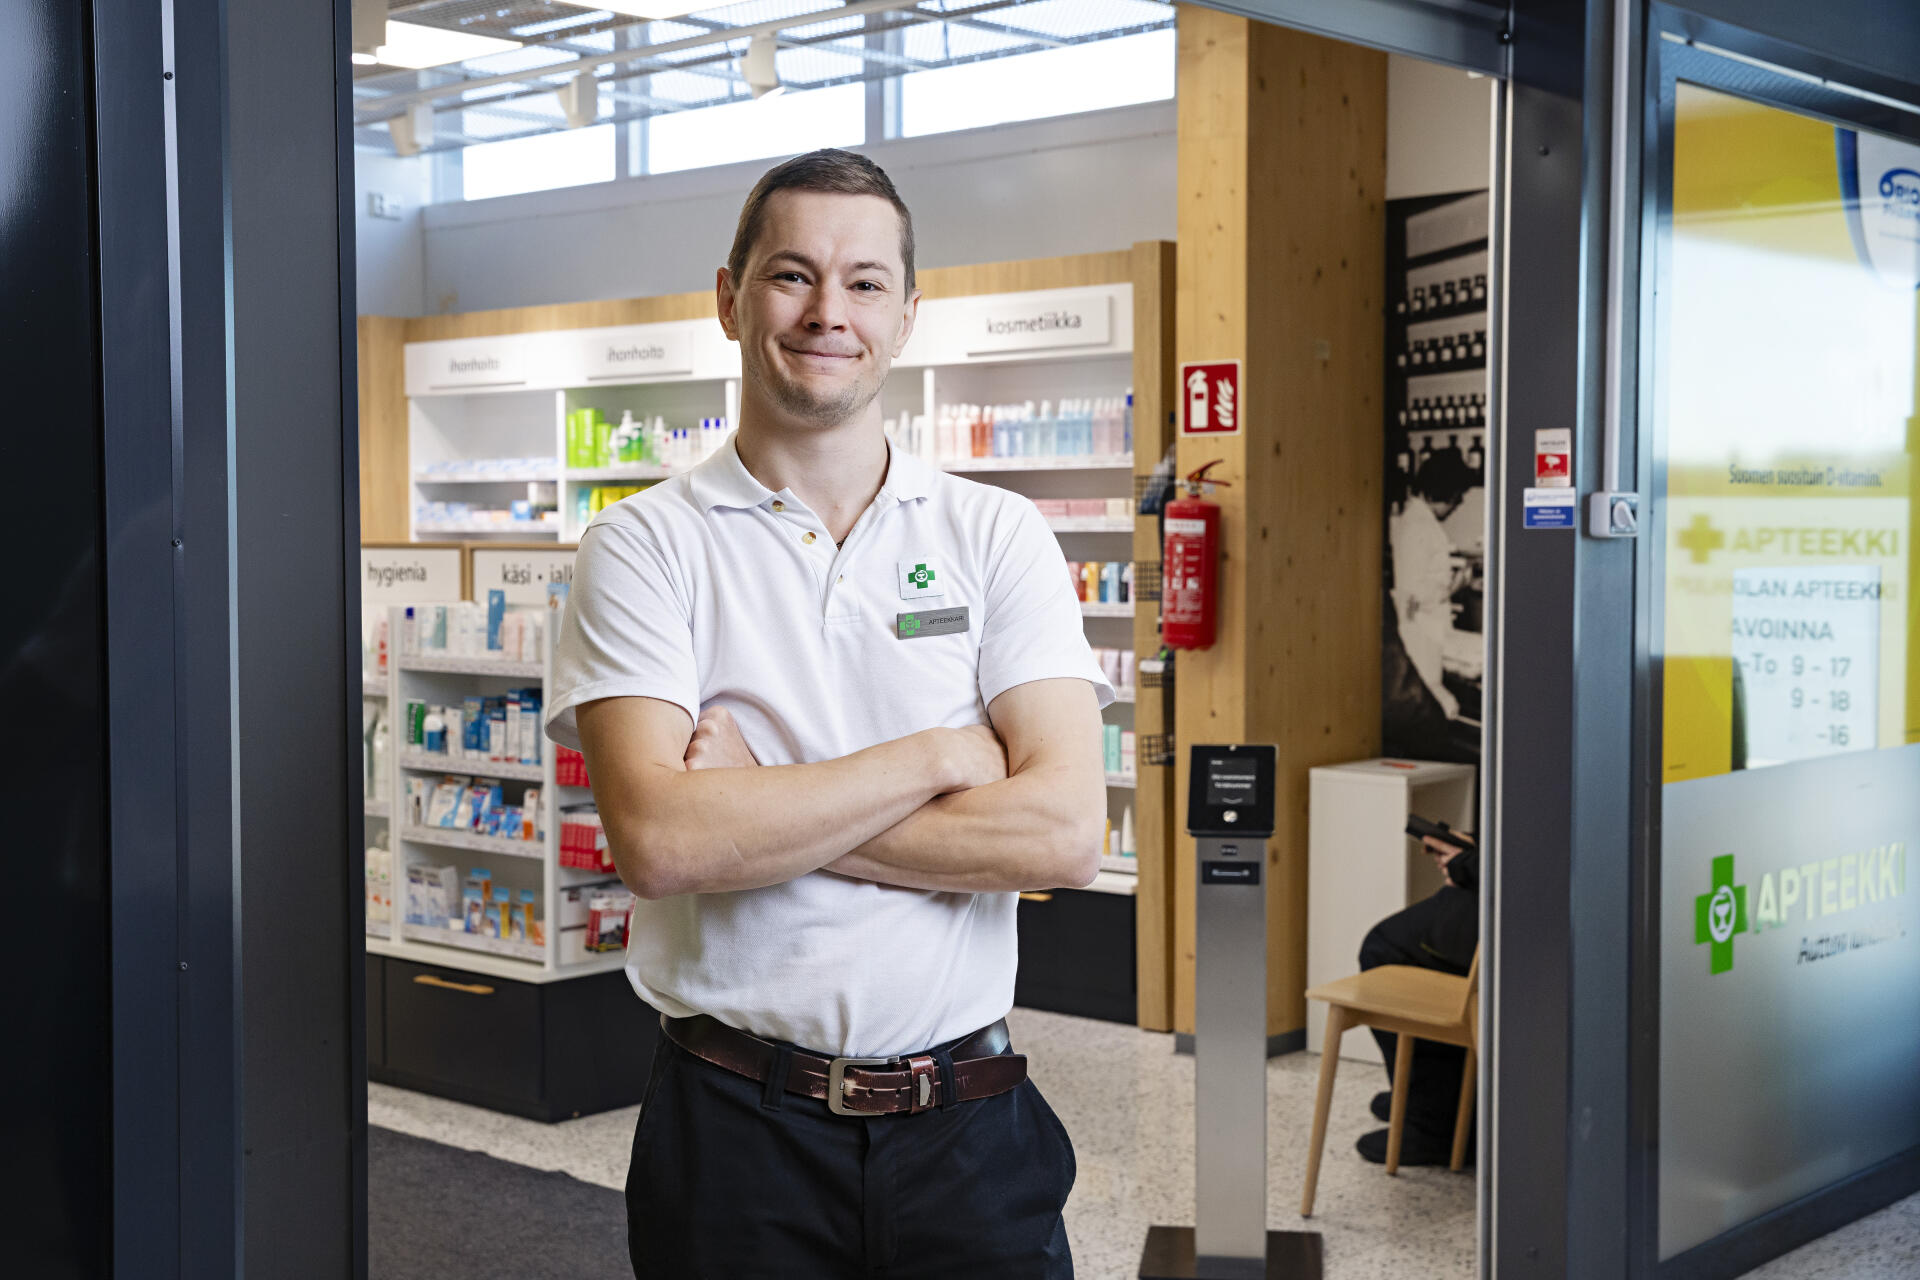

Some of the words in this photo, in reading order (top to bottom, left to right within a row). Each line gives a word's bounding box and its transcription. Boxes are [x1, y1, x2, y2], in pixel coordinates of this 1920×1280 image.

[987, 311, 1082, 335] kosmetiikka
[1732, 527, 1898, 557] APTEEKKI
[367, 561, 426, 587] hygienia
[502, 563, 531, 584] käsi
[1731, 617, 1834, 641] AVOINNA
[1791, 654, 1804, 676] 9
[1829, 656, 1851, 678] 17
[1791, 687, 1804, 709] 9
[1829, 690, 1850, 712] 18
[1754, 841, 1906, 935] APTEEKKI
